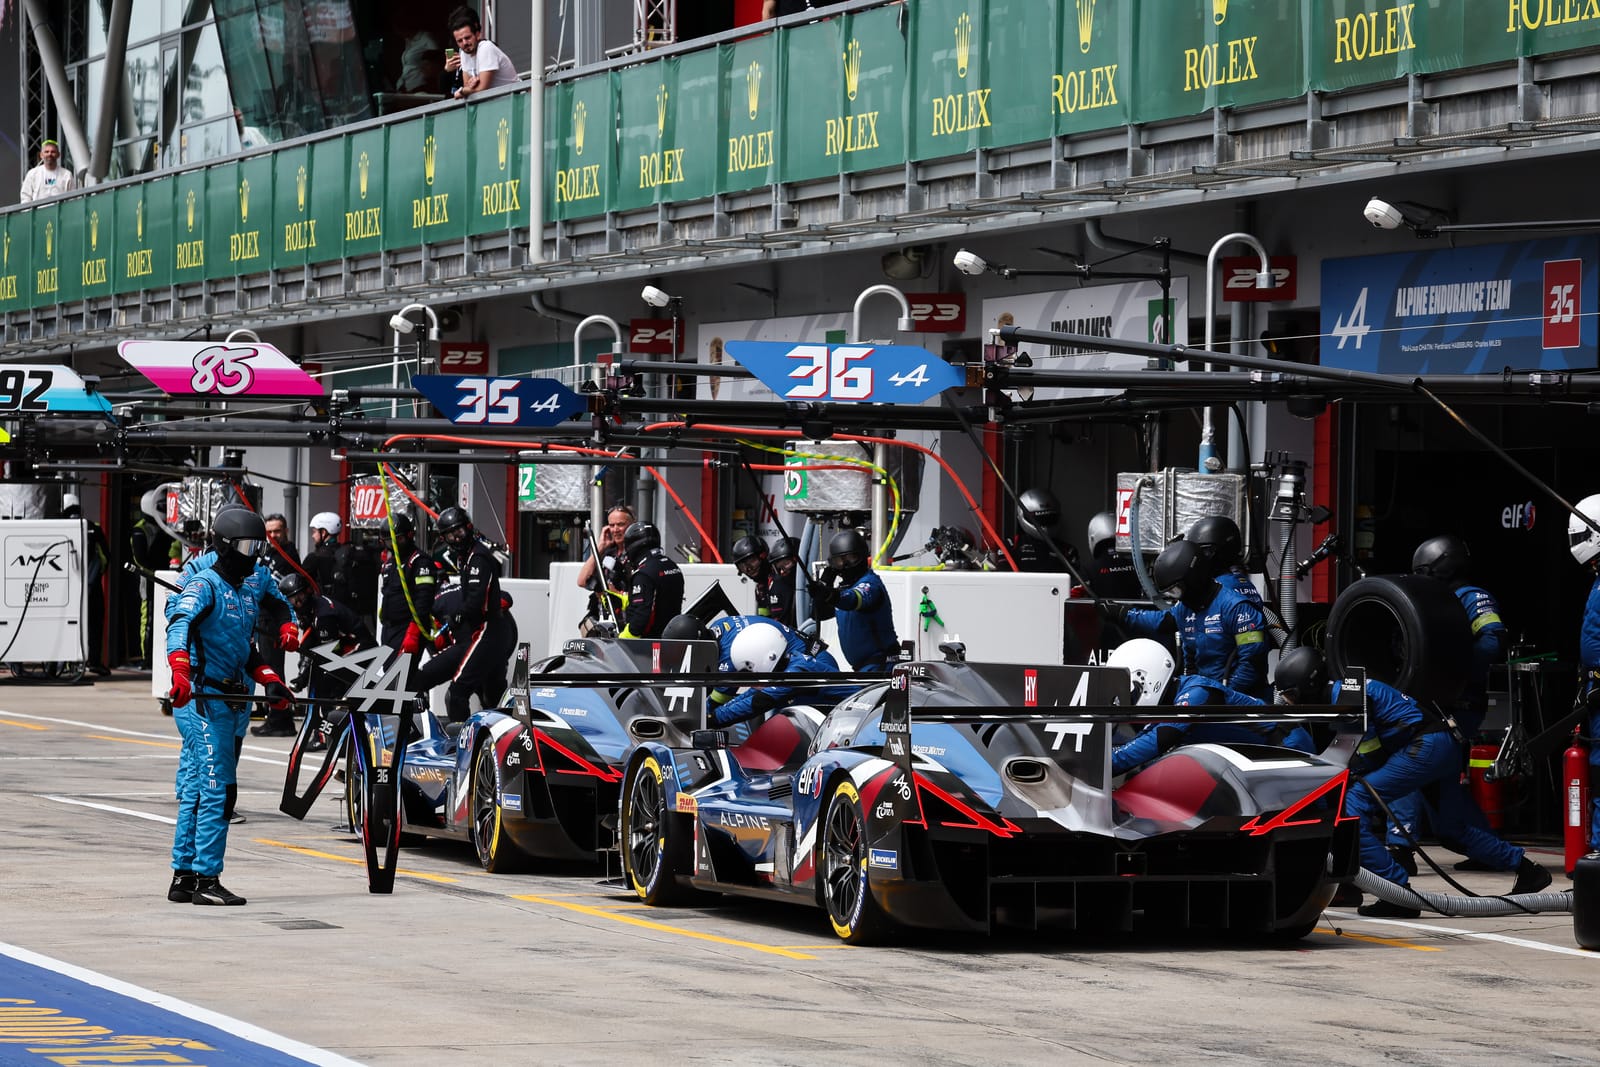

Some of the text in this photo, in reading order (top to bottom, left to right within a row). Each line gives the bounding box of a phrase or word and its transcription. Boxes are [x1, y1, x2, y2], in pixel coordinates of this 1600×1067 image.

[1334, 3, 1416, 63] ROLEX
[1184, 36, 1259, 92] ROLEX
[933, 89, 992, 136] ROLEX
[730, 131, 774, 172] ROLEX
[556, 165, 600, 203] ROLEX
[640, 149, 684, 188] ROLEX
[345, 207, 381, 241] ROLEX
[177, 240, 204, 269] ROLEX
[911, 303, 961, 321] 23
[1395, 279, 1512, 317] ALPINE ENDURANCE TEAM
[1549, 284, 1574, 324] 35
[631, 328, 675, 343] 24
[191, 346, 258, 395] 85
[442, 350, 484, 365] 25
[784, 346, 876, 400] 36
[0, 370, 54, 412] 92
[454, 378, 522, 424] 35
[356, 488, 385, 515] 007
[1502, 503, 1524, 529] elf
[563, 642, 586, 651] ALPINE
[891, 676, 901, 689] elf
[1025, 676, 1037, 702] HY
[319, 720, 332, 735] 35
[200, 720, 217, 789] ALPINE
[377, 769, 388, 783] 36
[410, 766, 443, 782] ALPINE
[798, 767, 815, 795] elf
[720, 812, 771, 831] ALPINE
